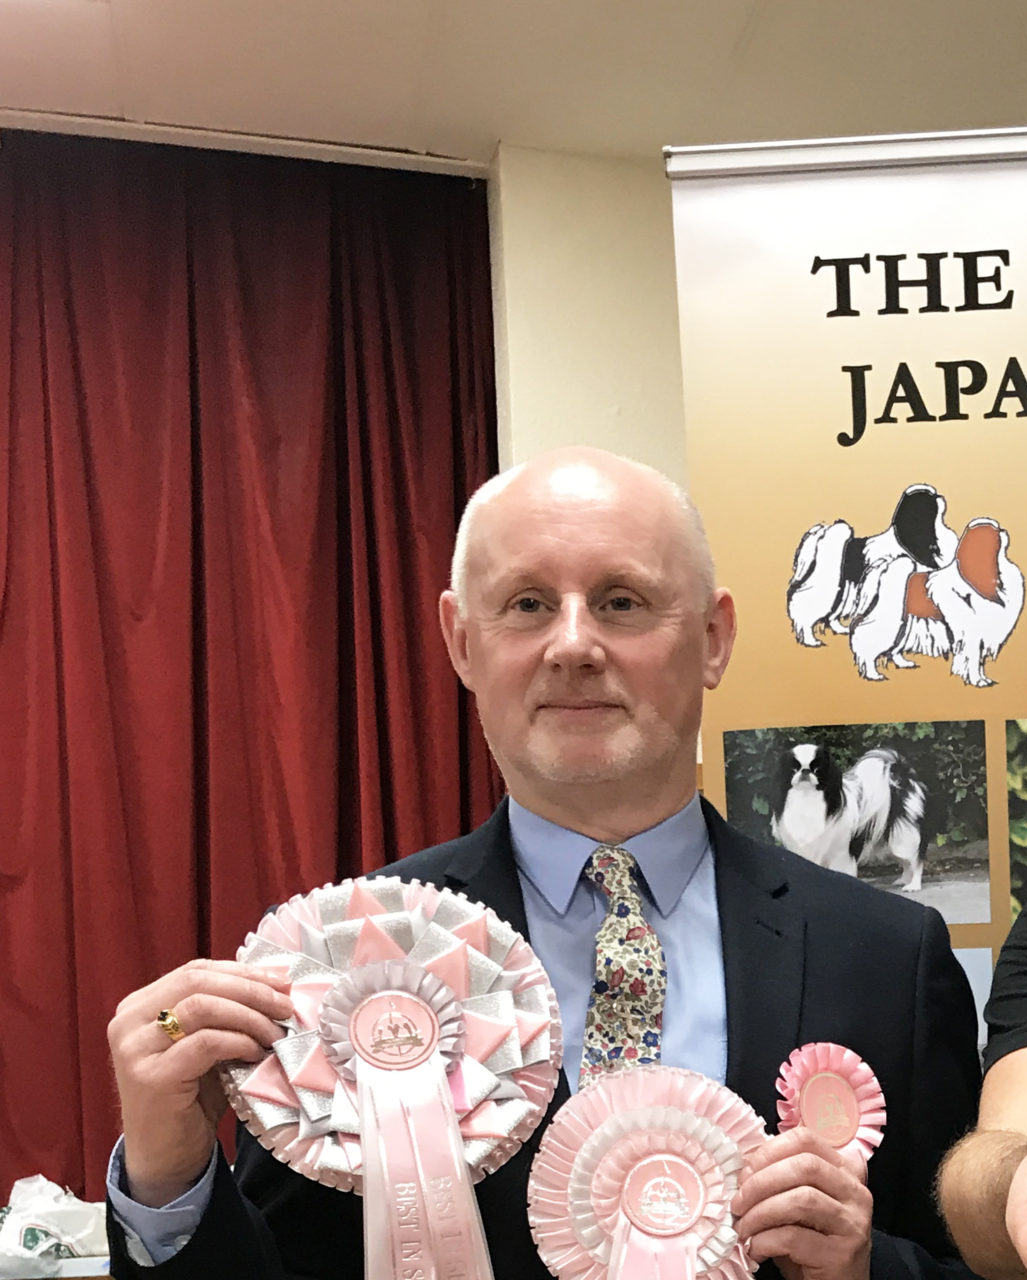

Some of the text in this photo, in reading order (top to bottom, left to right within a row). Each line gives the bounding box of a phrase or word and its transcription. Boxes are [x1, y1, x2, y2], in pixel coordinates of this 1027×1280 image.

[811, 248, 1014, 319] THE
[395, 1181, 420, 1231] BEST
[401, 1239, 424, 1264] IN
